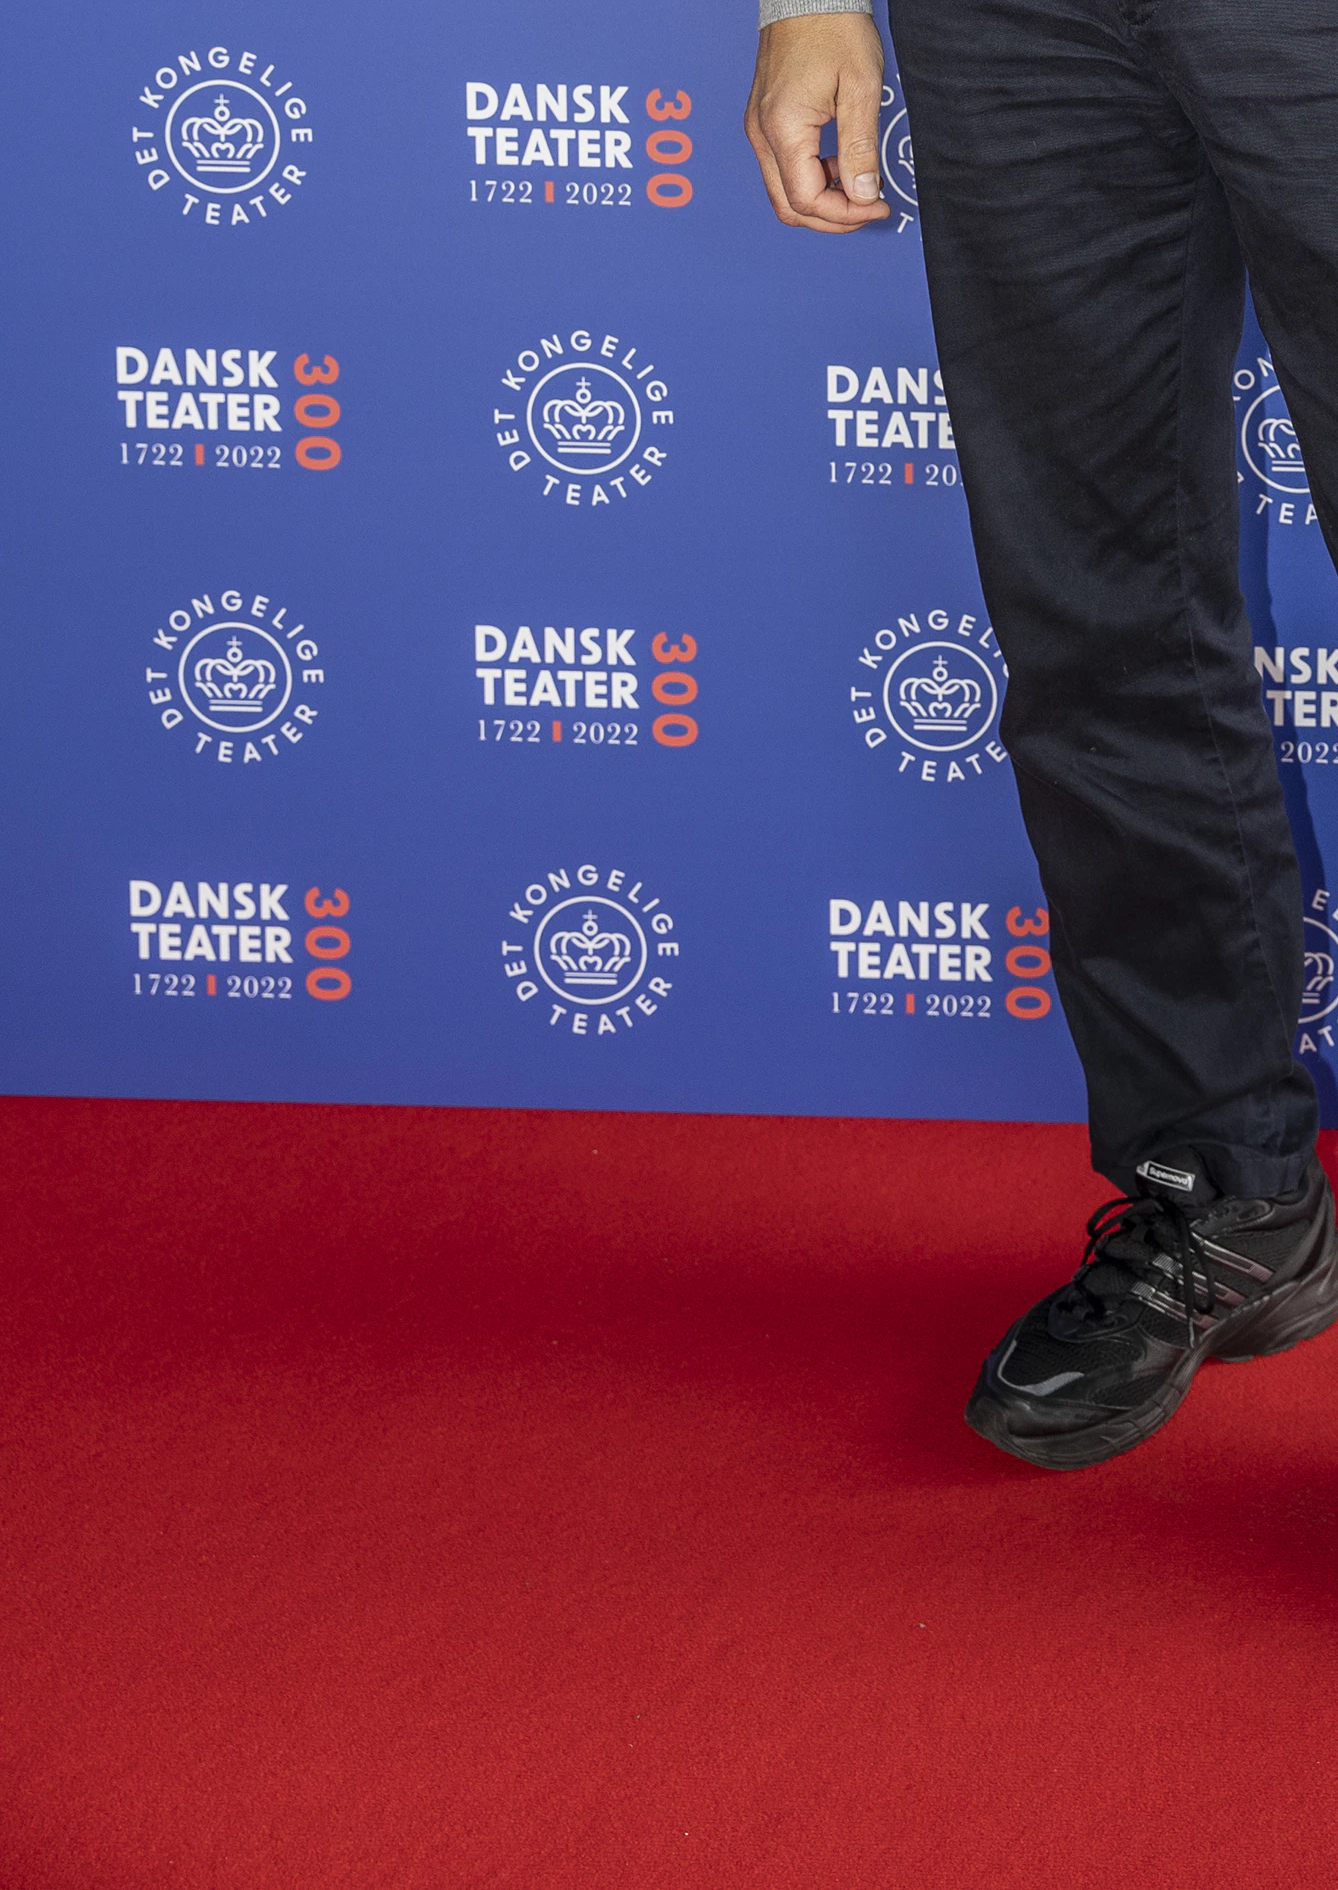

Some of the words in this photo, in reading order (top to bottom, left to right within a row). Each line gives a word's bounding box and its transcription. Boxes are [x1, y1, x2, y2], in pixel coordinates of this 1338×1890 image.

[139, 46, 313, 143] KONGELIGE
[465, 81, 630, 124] DANSK
[132, 126, 171, 191] DET
[466, 126, 634, 169] TEATER
[646, 89, 693, 208] 300
[182, 164, 307, 226] TEATER
[470, 179, 533, 204] 1722
[565, 181, 632, 207] 2022
[115, 346, 279, 389] DANSK
[116, 390, 283, 432] TEATER
[294, 354, 341, 470] 300
[121, 442, 184, 467] 1722
[215, 444, 281, 469] 2022
[829, 461, 893, 485] 1722
[474, 624, 637, 666] DANSK
[475, 667, 640, 710] TEATER
[652, 632, 698, 747] 300
[478, 719, 541, 743] 1722
[572, 721, 639, 746] 2022
[129, 879, 291, 921] DANSK
[508, 864, 680, 957] KONGELIGE
[829, 898, 991, 940] DANSK
[129, 922, 294, 964] TEATER
[305, 887, 351, 1000] 300
[829, 940, 994, 983] TEATER
[1005, 905, 1052, 1020] 300
[133, 973, 196, 997] 1722
[226, 975, 293, 999] 2022
[501, 940, 539, 1002] DET
[549, 976, 673, 1036] TEATER
[832, 991, 894, 1015] 1722
[925, 994, 992, 1018] 2022
